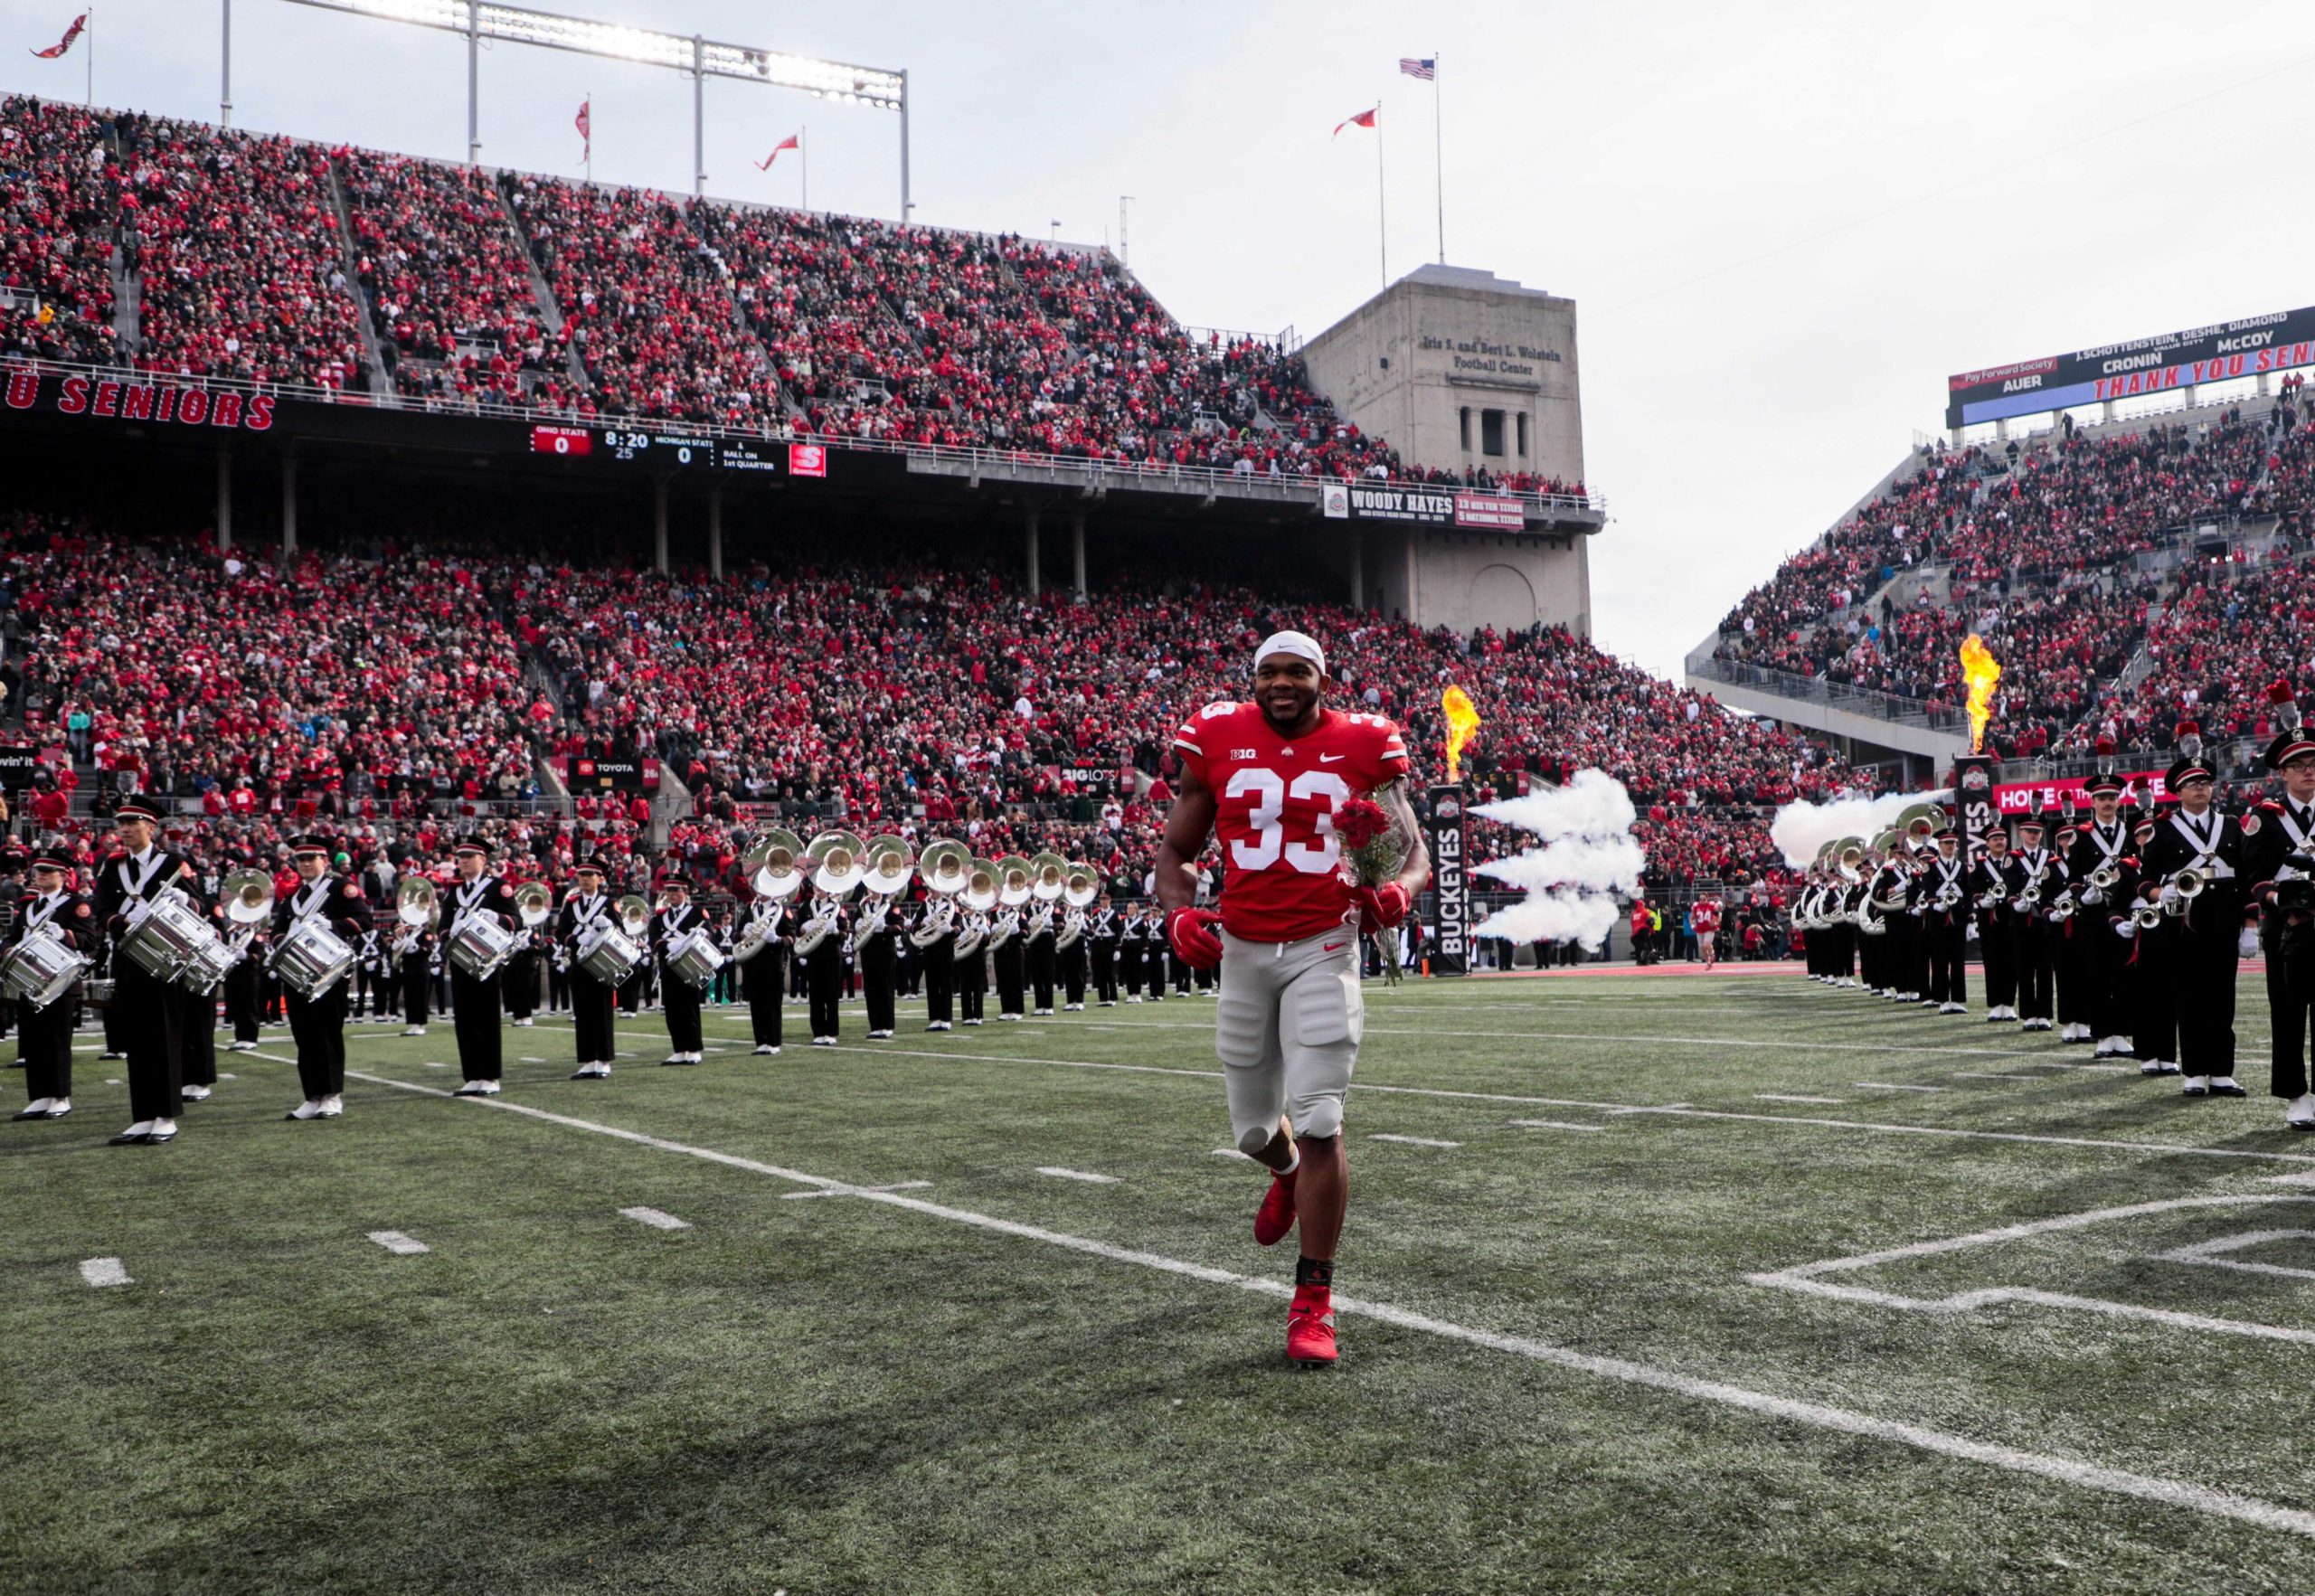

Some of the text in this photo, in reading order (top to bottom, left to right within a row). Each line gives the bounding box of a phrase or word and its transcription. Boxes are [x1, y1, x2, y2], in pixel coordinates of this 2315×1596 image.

[2182, 325, 2225, 342] DESHE,
[2229, 312, 2288, 332] DIAMOND
[1423, 336, 1561, 363] Iris S. and Bert L. Wolstein
[2153, 342, 2180, 353] VALUE
[2217, 331, 2273, 354] McCOY
[1453, 355, 1534, 376] Football Center
[1965, 359, 2053, 383] Pay Forward Society
[2102, 353, 2163, 374] CRONIN
[2003, 374, 2042, 393] AUER
[2094, 364, 2181, 400] THANK
[2192, 354, 2244, 382] YOU
[58, 377, 275, 430] SENIORS
[535, 425, 588, 437] OHIO STATE
[605, 430, 648, 449] 8:20
[554, 437, 569, 453] 0
[655, 436, 713, 449] MICHIGAN STATE
[615, 447, 633, 459] 25
[678, 447, 692, 463] 0
[723, 450, 742, 459] BALL
[737, 460, 774, 470] QUARTER
[1351, 490, 1403, 510] WOODY
[1406, 494, 1453, 515] HAYES
[1459, 511, 1465, 521] 5
[24, 756, 34, 767] it
[597, 763, 634, 772] TOYOTA
[2001, 787, 2055, 808] HOE
[1225, 767, 1353, 874] 33
[1438, 827, 1462, 955] BUCKEYES
[1696, 911, 1712, 923] 34
